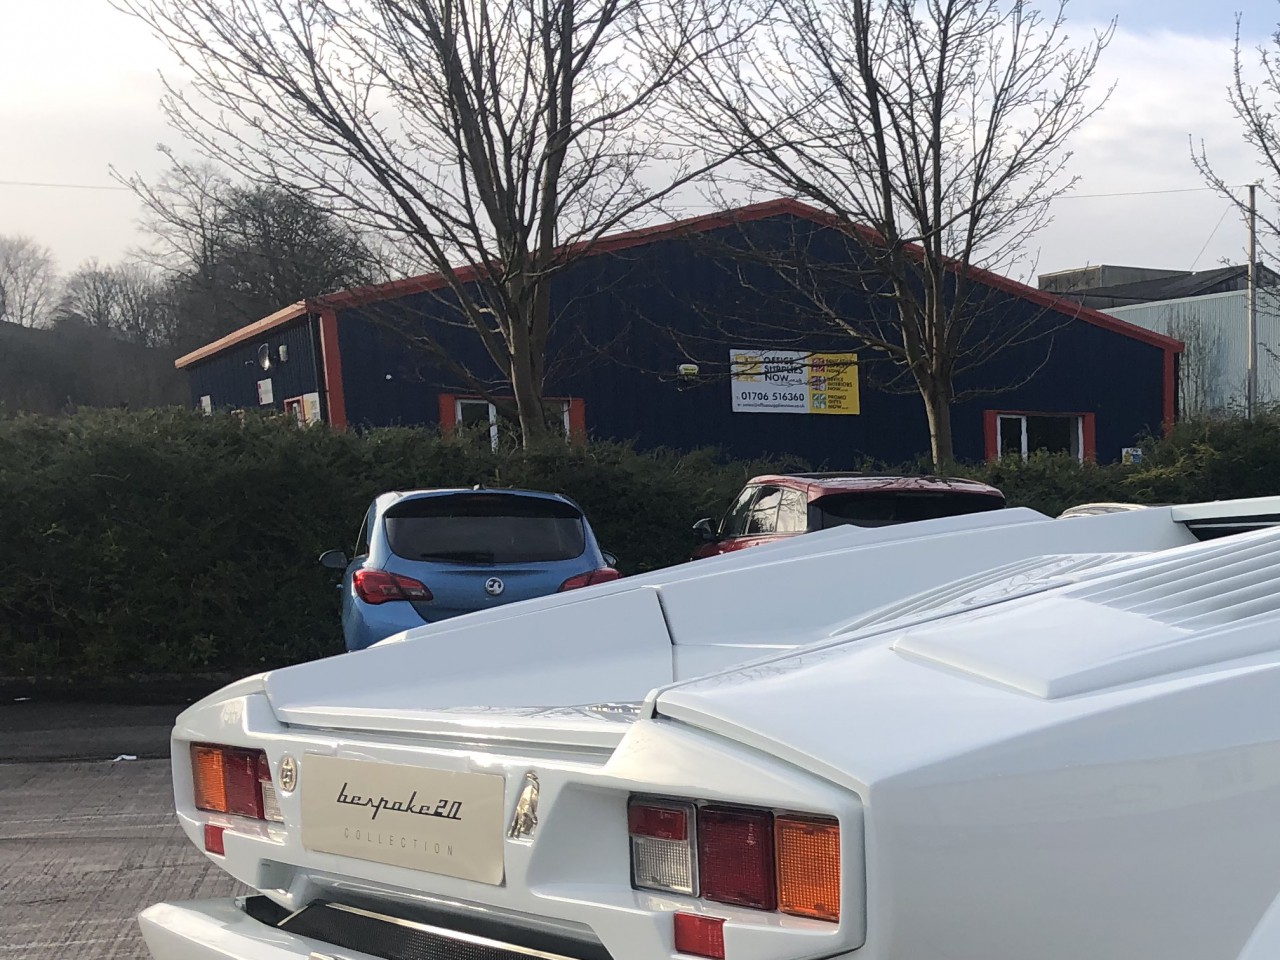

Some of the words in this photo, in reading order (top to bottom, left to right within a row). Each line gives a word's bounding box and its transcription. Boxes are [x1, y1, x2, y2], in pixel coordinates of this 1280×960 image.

[741, 392, 769, 401] 01706
[772, 392, 805, 401] 516360
[336, 782, 463, 820] bespoke20
[344, 827, 453, 856] COLLECTION
